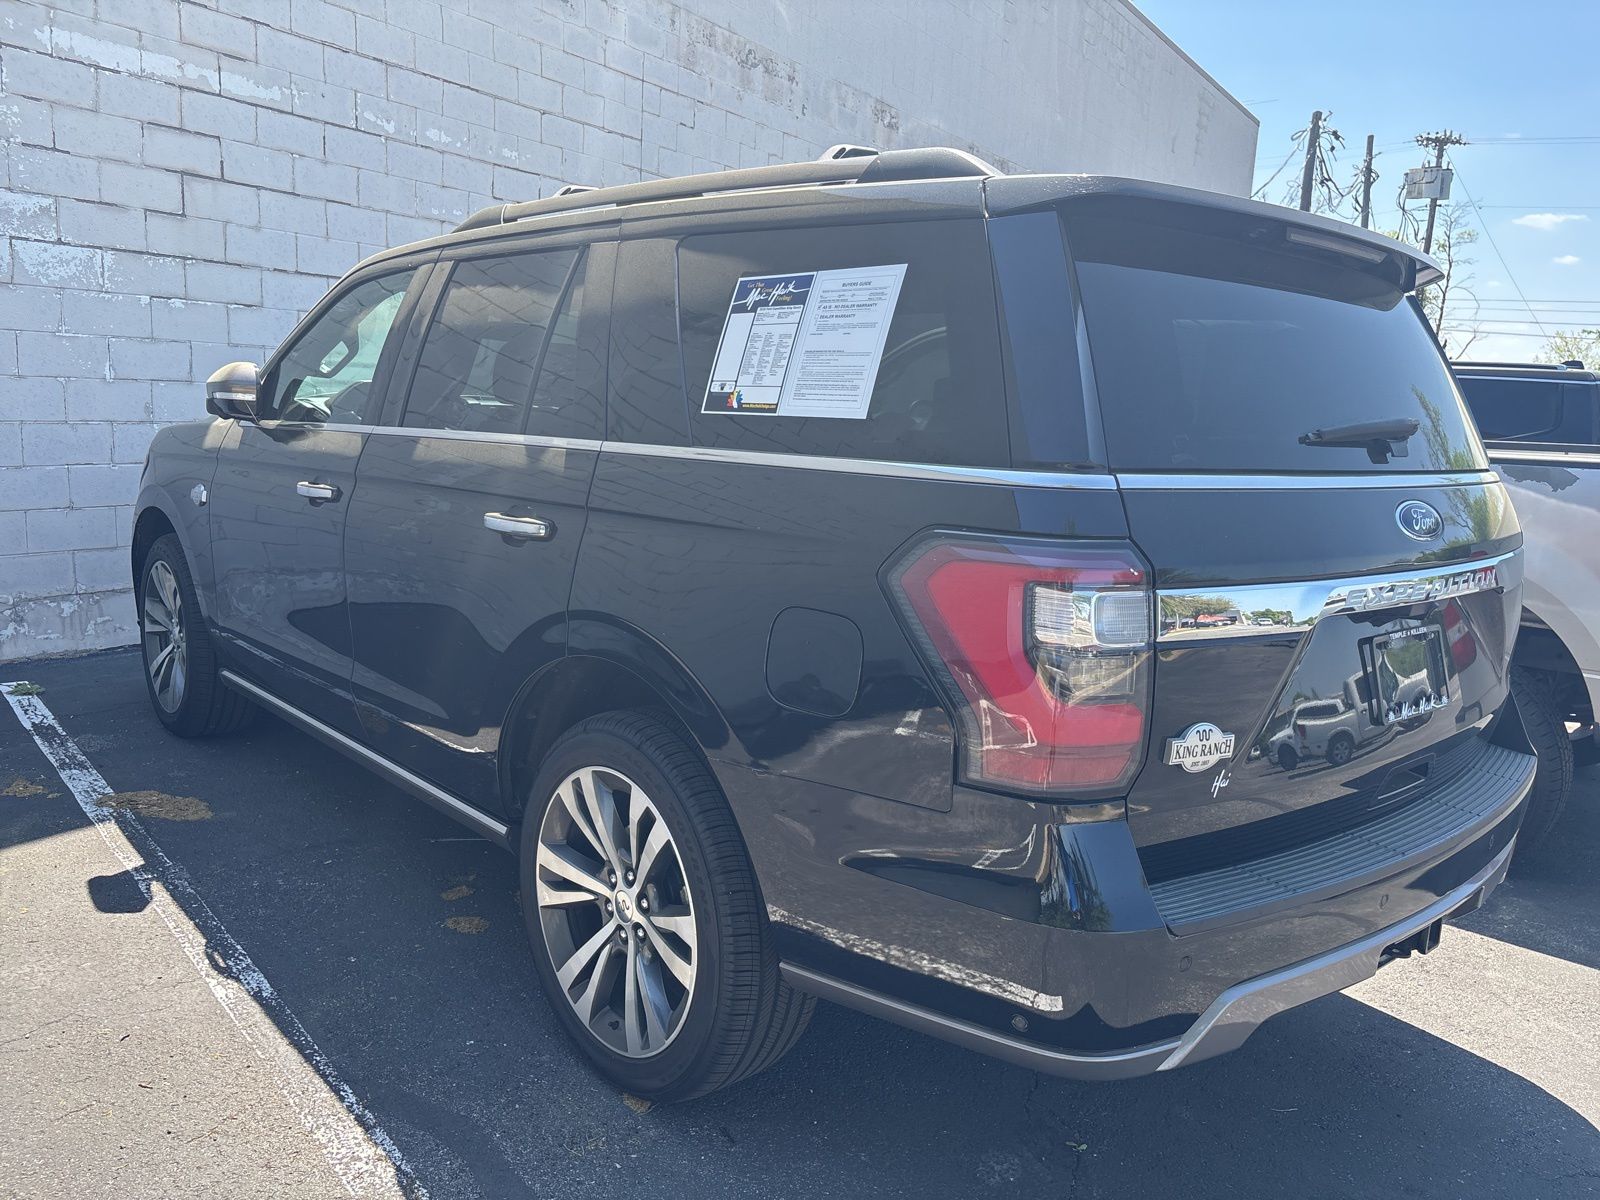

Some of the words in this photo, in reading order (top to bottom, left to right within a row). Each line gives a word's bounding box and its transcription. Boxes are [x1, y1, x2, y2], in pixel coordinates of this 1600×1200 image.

[737, 288, 768, 310] Mac
[768, 280, 805, 306] Haik
[1411, 508, 1436, 531] Ford
[1345, 568, 1497, 609] EXPEDITION
[1390, 631, 1407, 640] TEMPLE
[1411, 627, 1428, 635] KILLEEN
[1397, 702, 1418, 721] Mac
[1419, 695, 1444, 714] Haik
[1174, 744, 1199, 760] KING
[1200, 739, 1232, 757] RANCH
